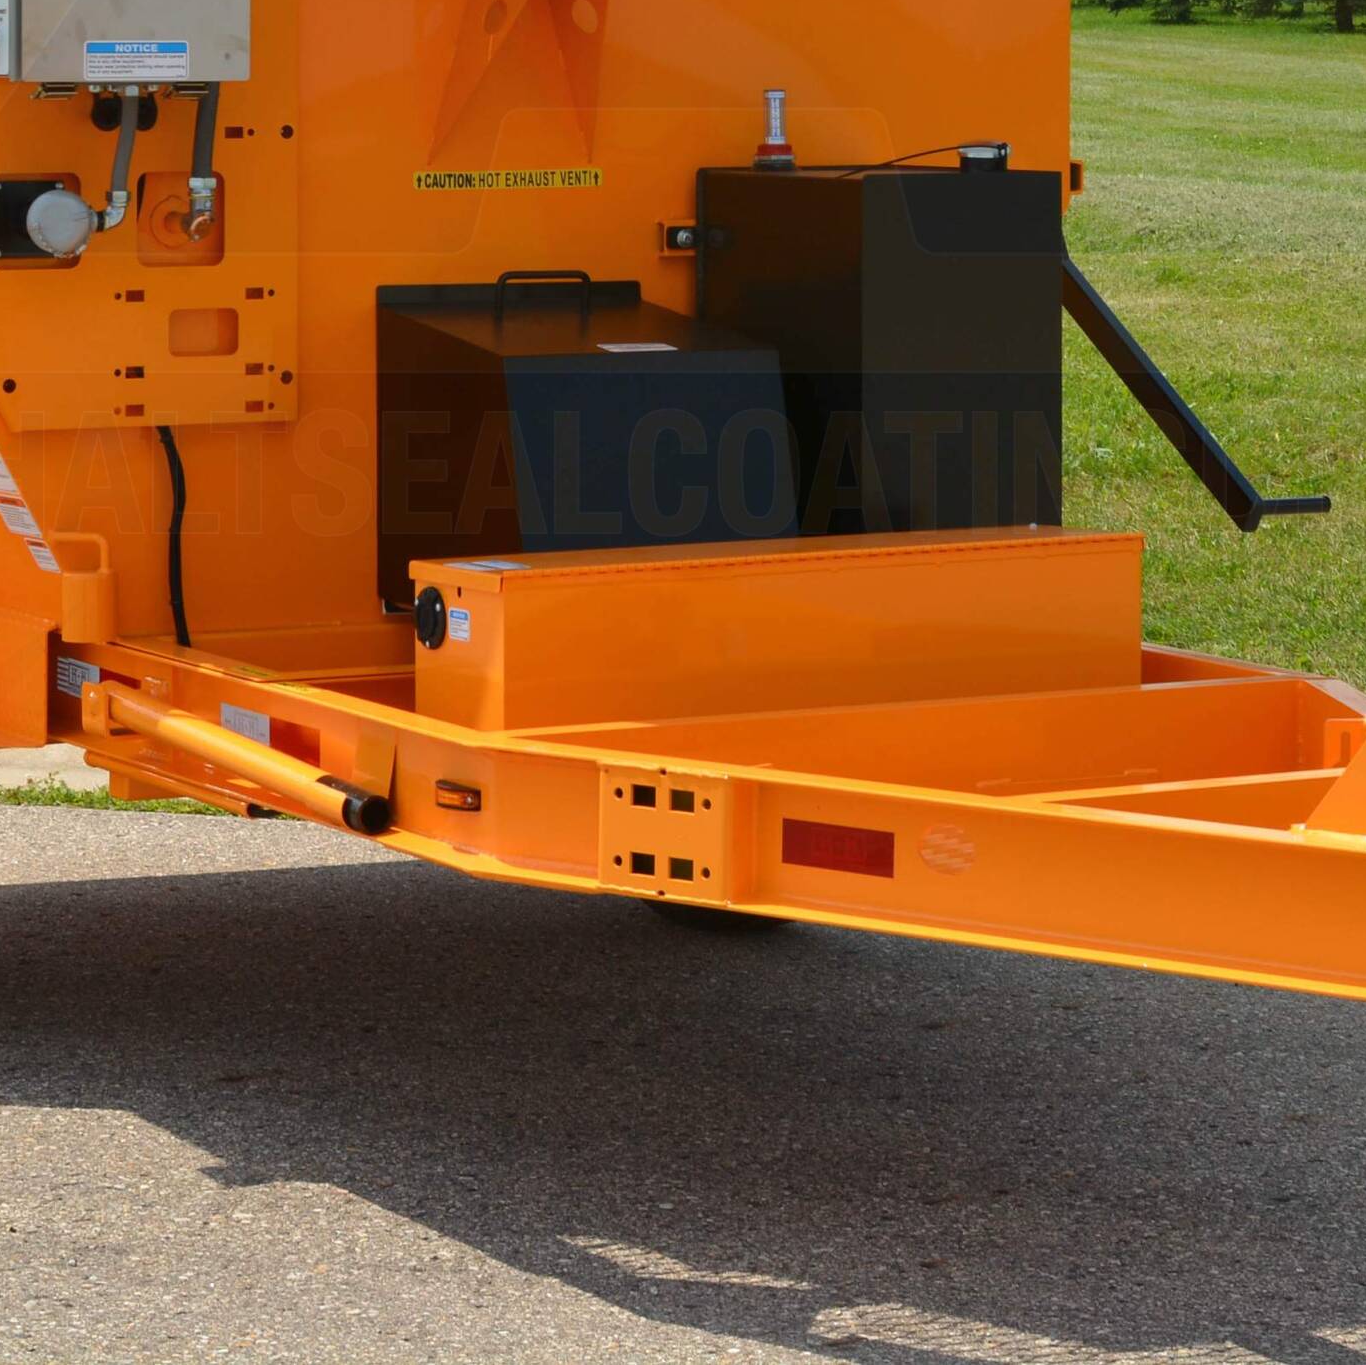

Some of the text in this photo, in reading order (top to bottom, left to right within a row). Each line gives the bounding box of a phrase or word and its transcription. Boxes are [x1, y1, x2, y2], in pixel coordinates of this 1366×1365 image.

[115, 44, 158, 52] NOTICE
[424, 170, 592, 189] CAUTION: HOT EXHAUST VENT!
